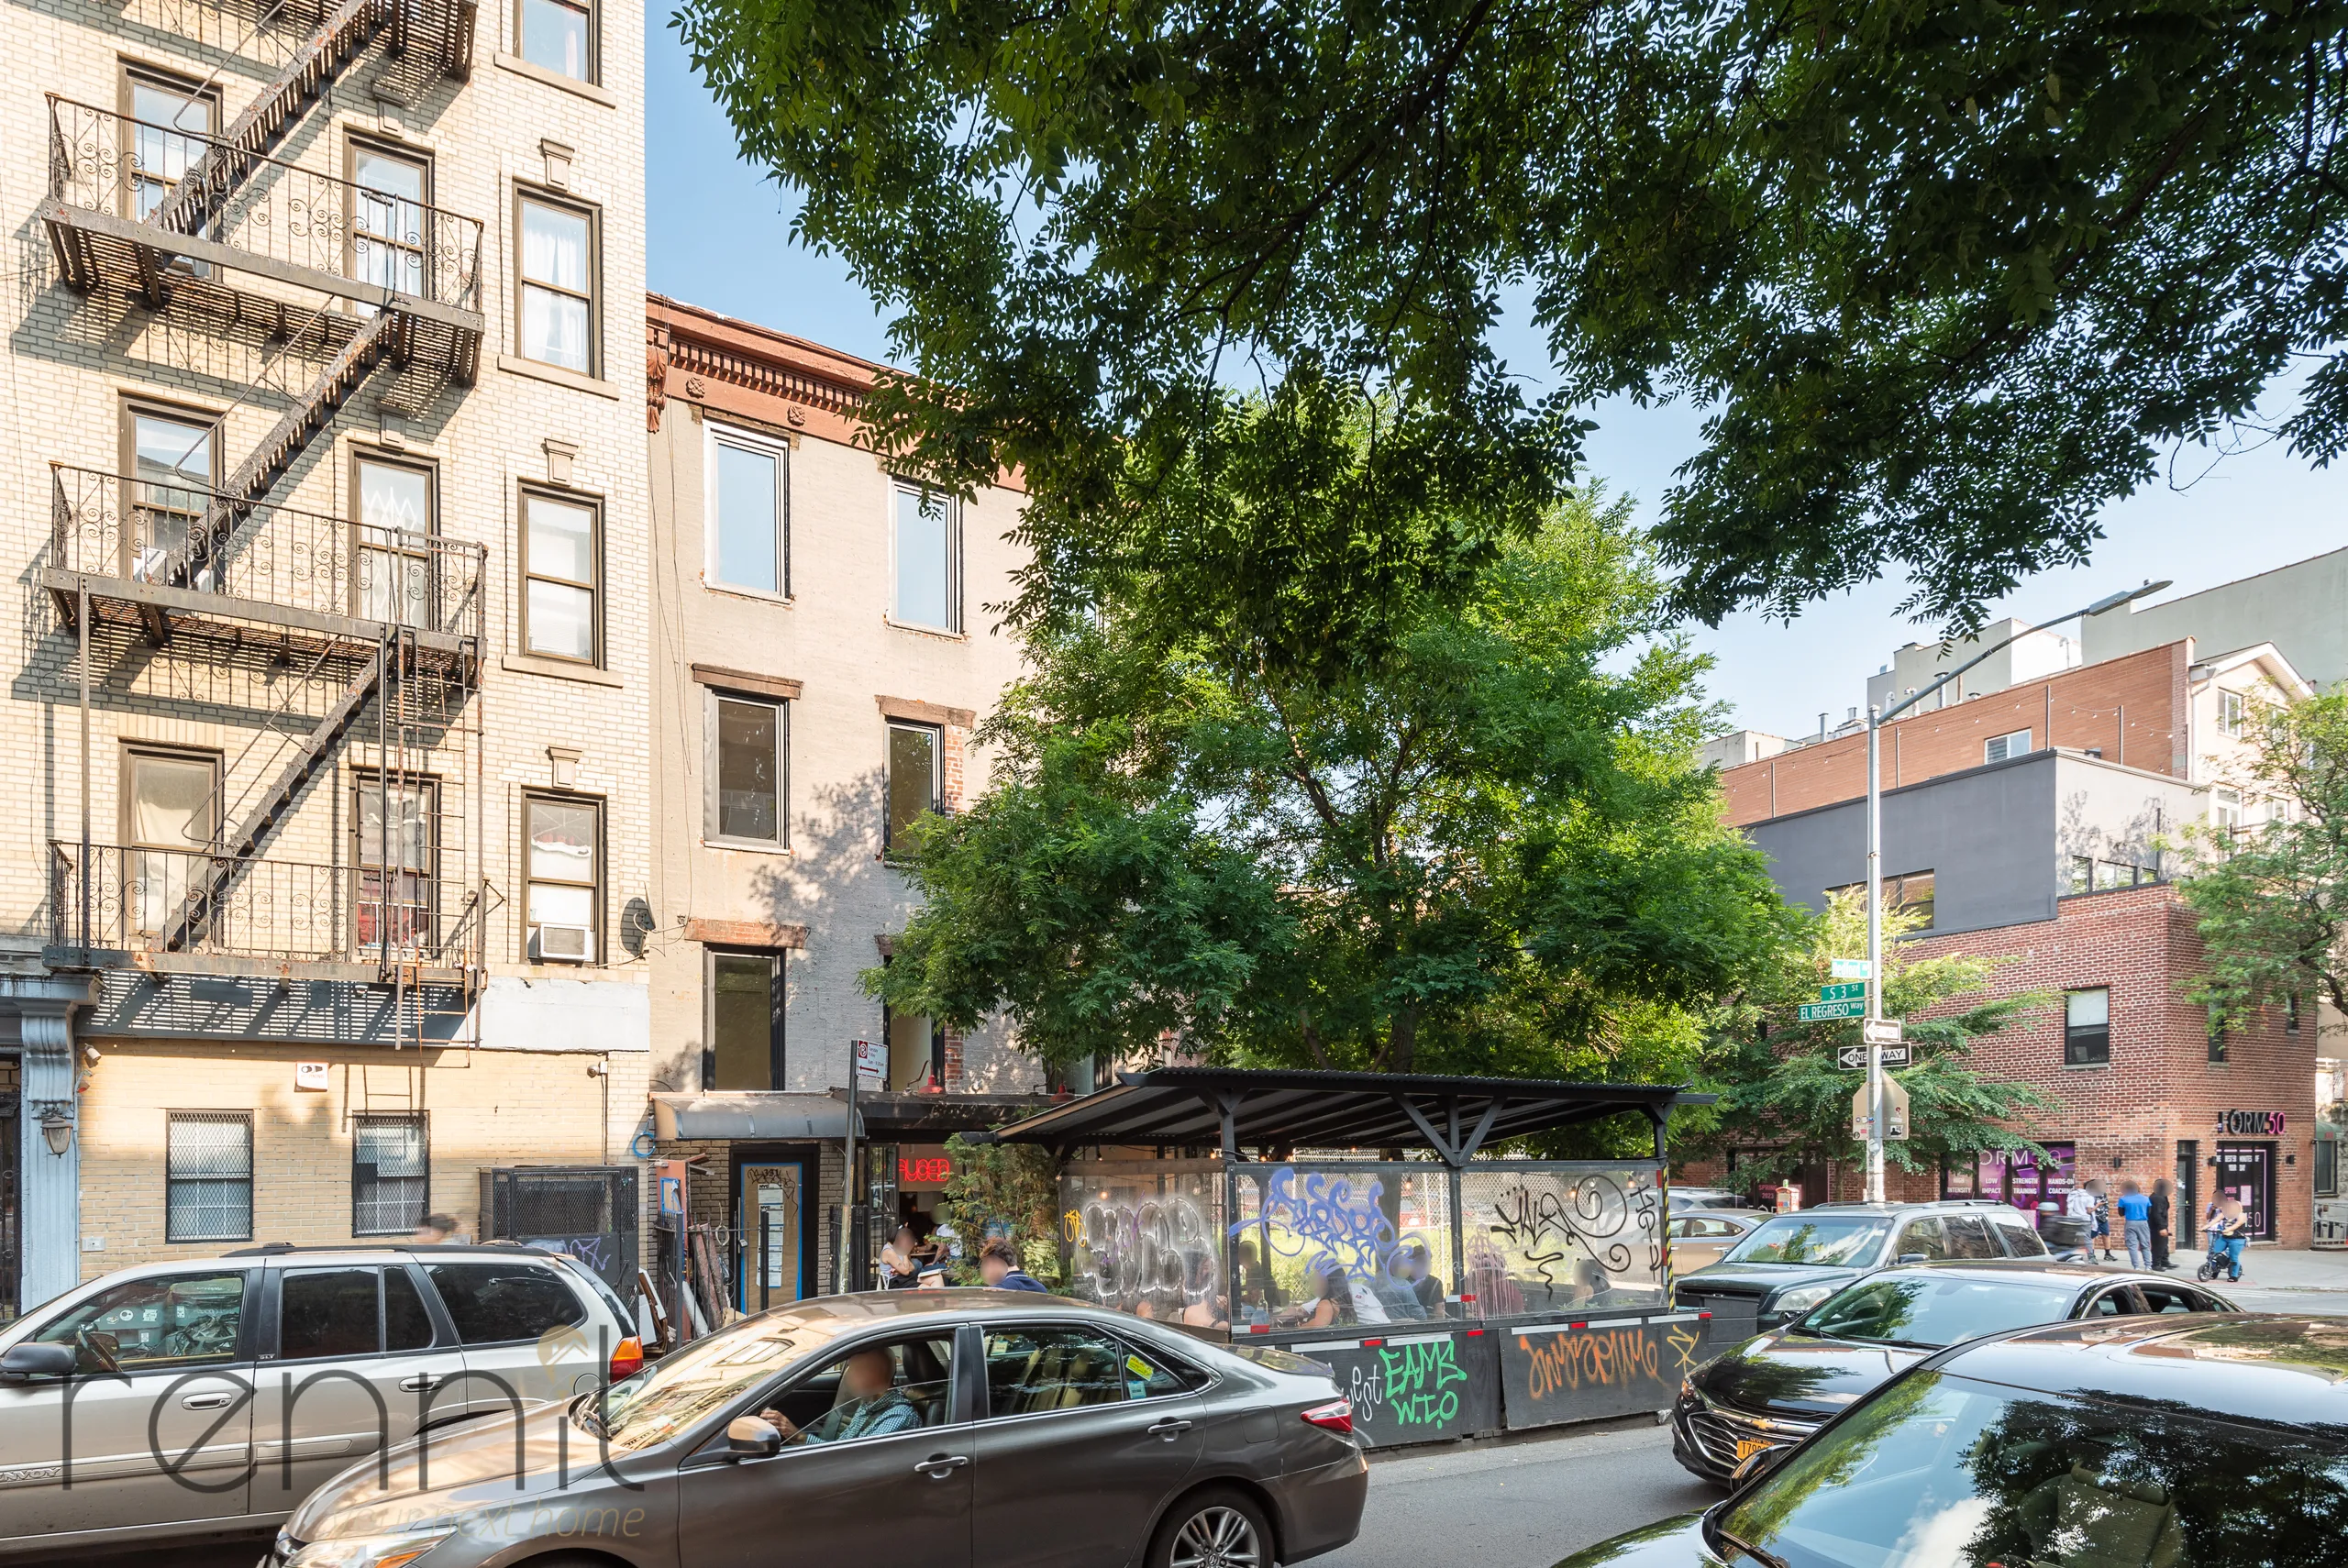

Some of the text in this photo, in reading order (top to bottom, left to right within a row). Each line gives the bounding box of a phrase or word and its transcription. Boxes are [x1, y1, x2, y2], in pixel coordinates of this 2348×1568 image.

[1830, 984, 1859, 999] S 3 St
[1800, 1001, 1864, 1020] EL REGRESO Way
[1847, 1050, 1903, 1063] ONE WAY
